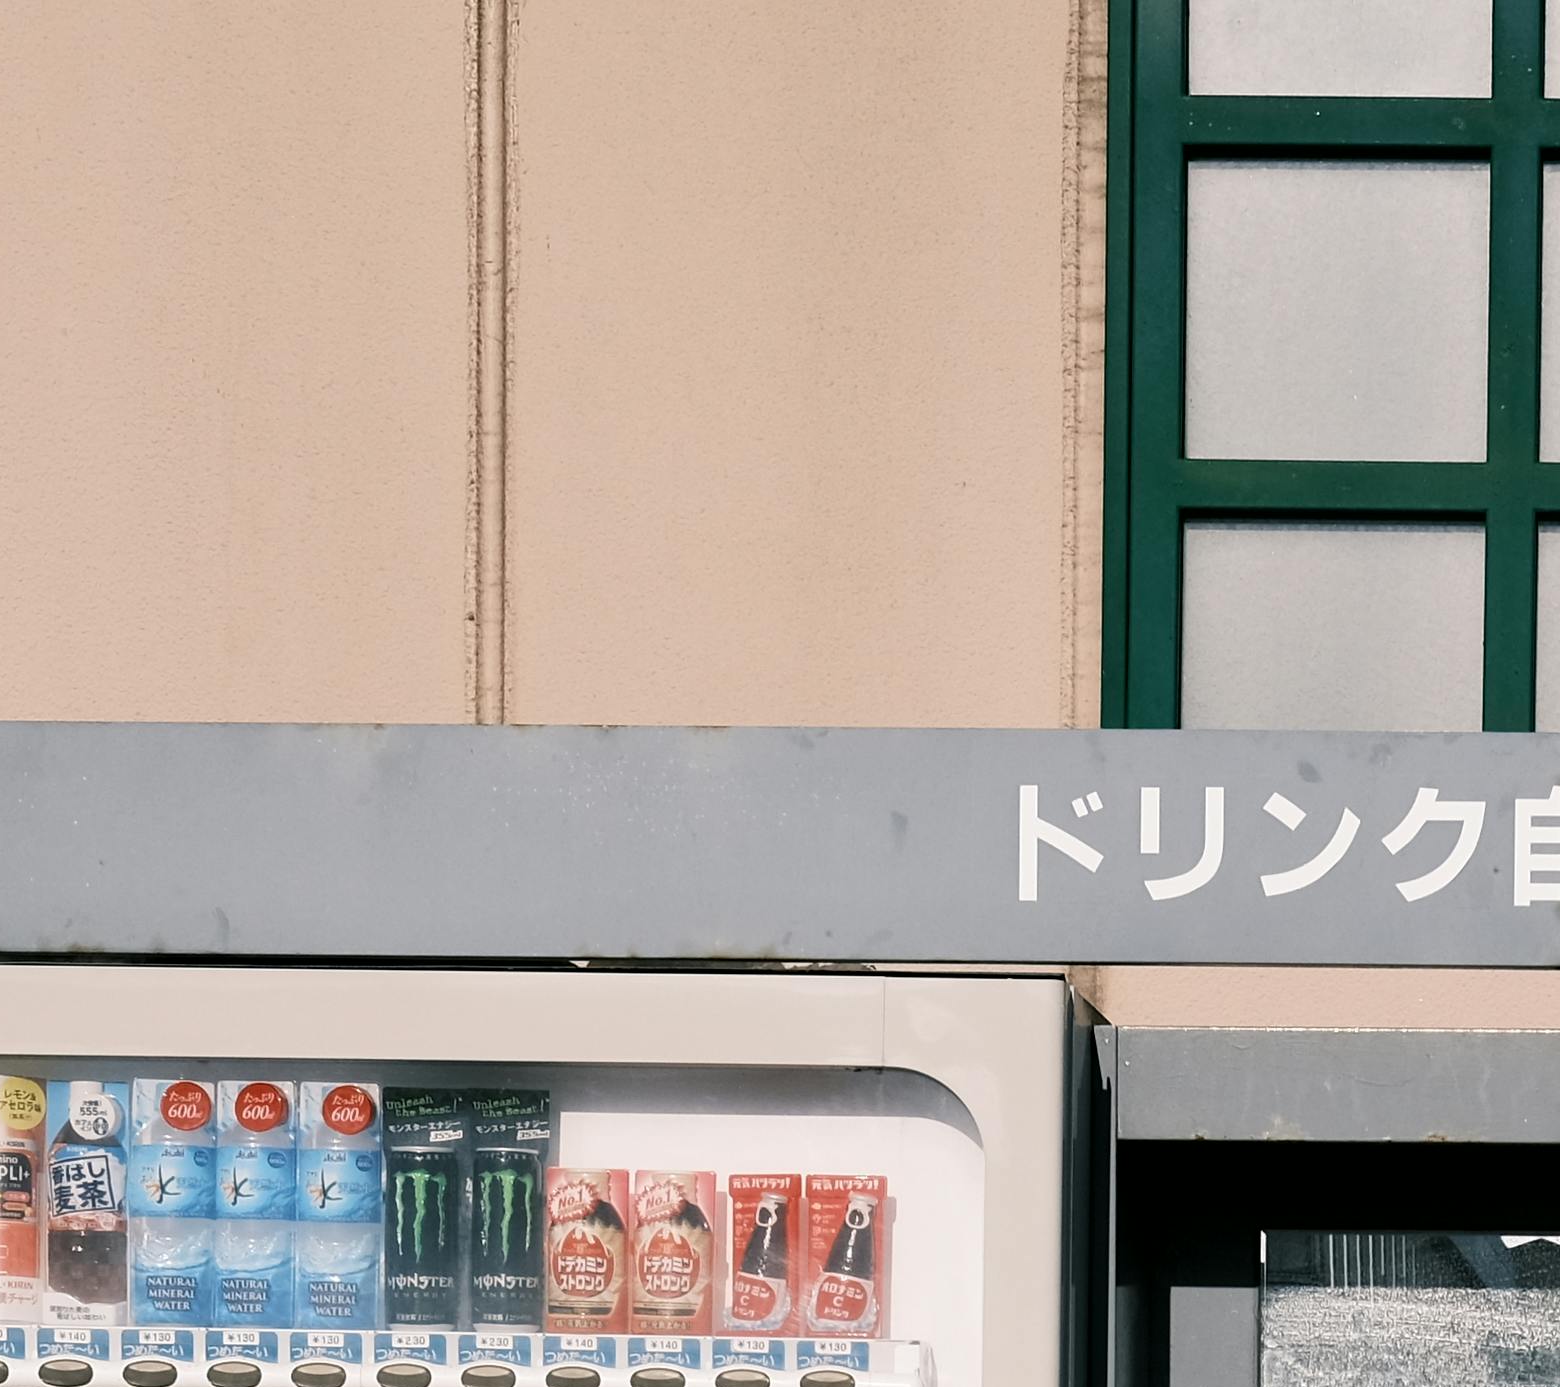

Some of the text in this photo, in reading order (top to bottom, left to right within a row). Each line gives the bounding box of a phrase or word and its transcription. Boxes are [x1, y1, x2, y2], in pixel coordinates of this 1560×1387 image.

[52, 1181, 110, 1213] 麦茶
[557, 1255, 606, 1273] ドデカミン
[643, 1255, 693, 1273] ドデカミン
[146, 1276, 198, 1288] NATURAL
[222, 1278, 269, 1290] NATURAL
[559, 1274, 605, 1292] ストロング
[645, 1276, 690, 1293] ストロング
[148, 1288, 195, 1298] MINERAL
[222, 1290, 267, 1301] MINERAL
[153, 1299, 191, 1311] WATER
[226, 1302, 263, 1313] WATER
[227, 1333, 255, 1343] ¥130
[480, 1336, 509, 1347] ¥230
[565, 1338, 594, 1348] ¥140
